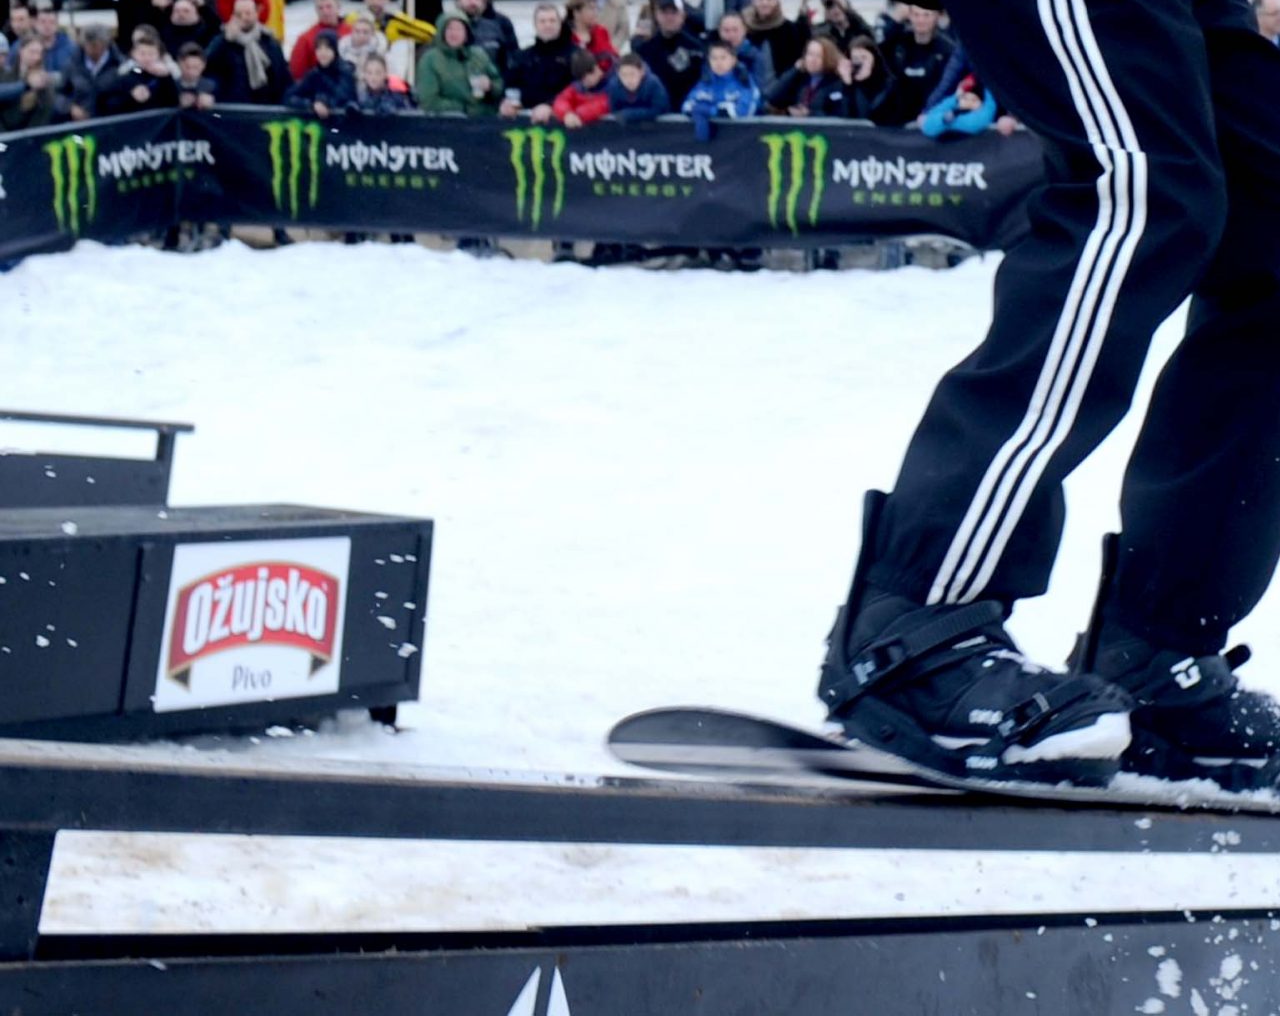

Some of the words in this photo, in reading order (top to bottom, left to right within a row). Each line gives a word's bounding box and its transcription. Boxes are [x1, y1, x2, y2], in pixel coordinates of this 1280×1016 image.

[98, 139, 215, 178] MONSTER
[326, 140, 459, 172] MONSTER
[569, 148, 715, 181] MONSTER
[832, 155, 987, 190] MONSTER
[182, 567, 329, 655] Ožujsko
[231, 665, 273, 690] Pivo
